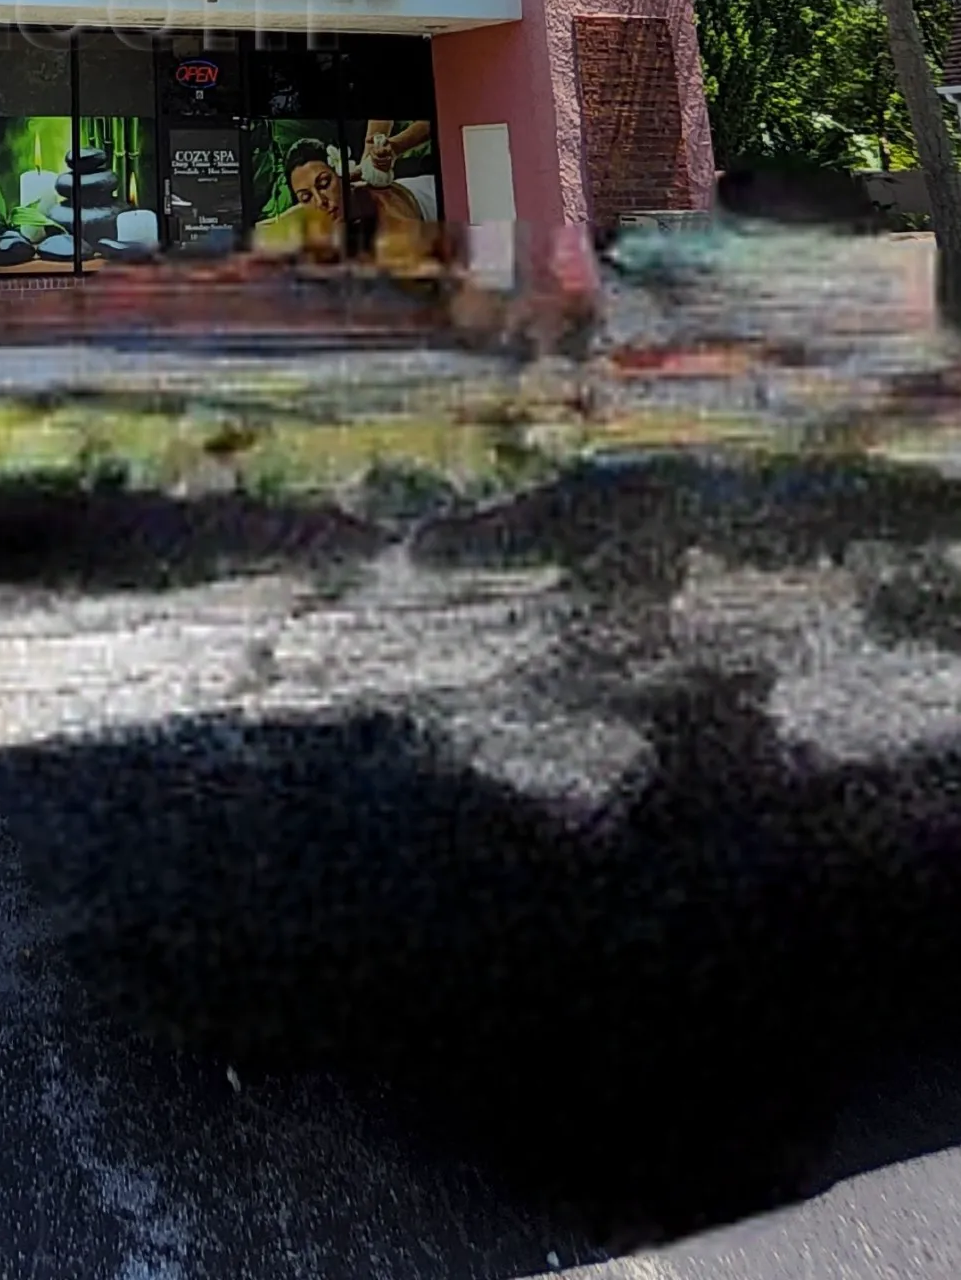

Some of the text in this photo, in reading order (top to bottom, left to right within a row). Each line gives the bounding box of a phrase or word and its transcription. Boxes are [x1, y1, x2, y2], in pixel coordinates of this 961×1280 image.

[176, 66, 219, 83] OPEN
[175, 150, 235, 162] COZY SPA
